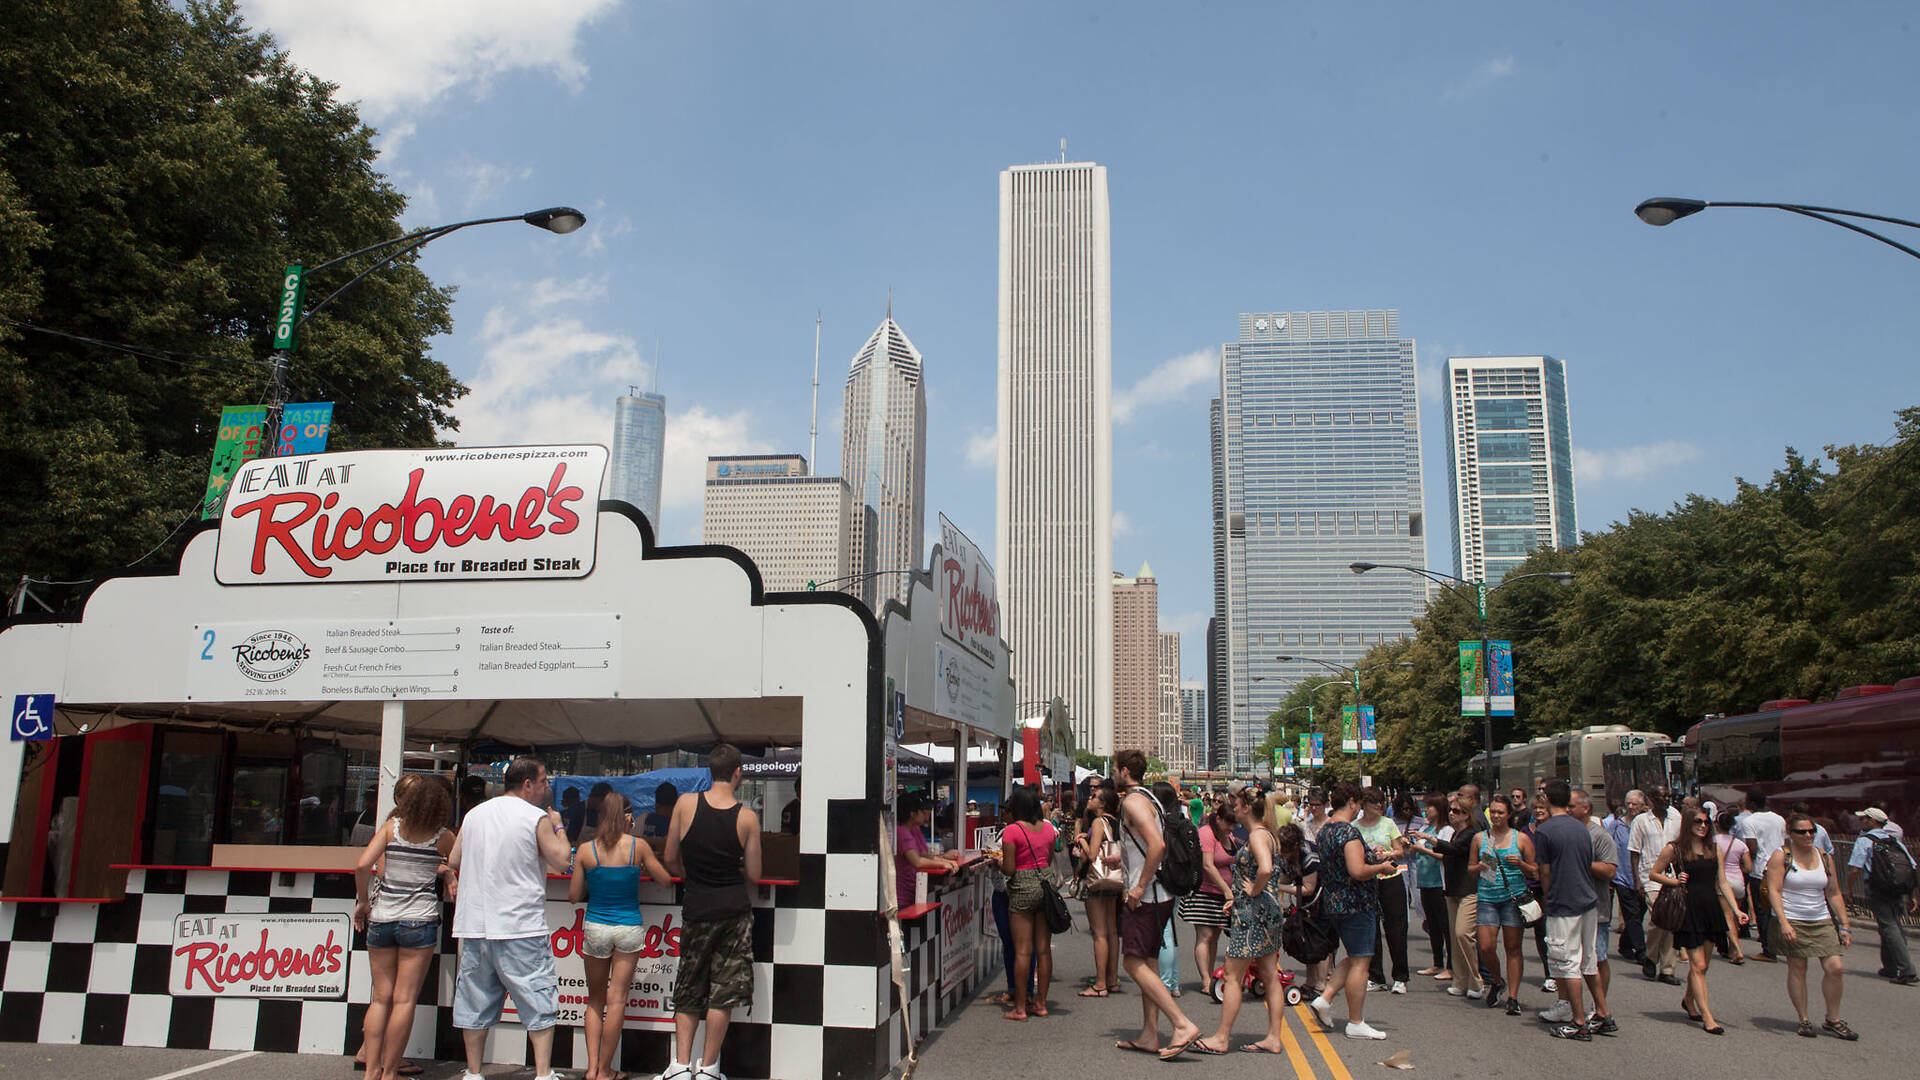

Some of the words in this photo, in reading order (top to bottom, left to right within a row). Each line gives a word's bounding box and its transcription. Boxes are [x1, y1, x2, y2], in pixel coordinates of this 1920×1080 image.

[277, 274, 299, 340] C220
[284, 410, 330, 424] TASTE
[220, 426, 241, 440] OF
[304, 424, 328, 438] OF
[424, 450, 588, 463] www.ricobenespizza.com
[239, 459, 318, 493] EAT
[316, 463, 356, 487] AT
[231, 462, 584, 579] Ricobene's
[386, 561, 428, 574] Place
[434, 560, 455, 573] for
[461, 559, 527, 572] Breaded
[533, 558, 581, 571] Steak
[326, 629, 349, 637] Italian
[350, 629, 380, 637] Breaded
[455, 626, 461, 635] 9
[480, 626, 501, 634] Taste
[502, 624, 515, 634] of:
[250, 633, 272, 644] Since
[274, 632, 293, 643] 1946
[200, 629, 216, 661] 2
[325, 645, 341, 653] Beef
[349, 645, 378, 655] Sausage
[380, 645, 405, 653] Combo
[455, 643, 461, 651] 9
[479, 643, 504, 652] Italian
[505, 642, 538, 651] Breaded
[540, 642, 562, 650] Steak
[606, 641, 611, 649] 5
[231, 640, 311, 665] Ricobene's
[239, 661, 267, 680] SERVING
[268, 660, 301, 680] CHICAGO
[323, 663, 343, 672] Fresh
[345, 663, 357, 672] Cut
[359, 663, 383, 671] French
[385, 663, 402, 671] Fries
[479, 662, 503, 671] Italian
[504, 661, 537, 670] Breaded
[539, 660, 575, 671] Eggplant
[603, 661, 609, 669] 5
[453, 669, 459, 677] 6
[321, 686, 353, 694] Boneless
[354, 685, 379, 694] Buffalo
[380, 685, 409, 693] Chicken
[409, 685, 431, 695] Wings
[452, 685, 458, 693] 8
[179, 917, 217, 938] EAT
[219, 923, 240, 939] AT
[175, 928, 343, 993] Ricobene's
[650, 964, 673, 974] 1946
[250, 985, 271, 993] Place
[273, 985, 284, 993] for
[285, 985, 316, 993] Breaded
[318, 985, 340, 993] Steak
